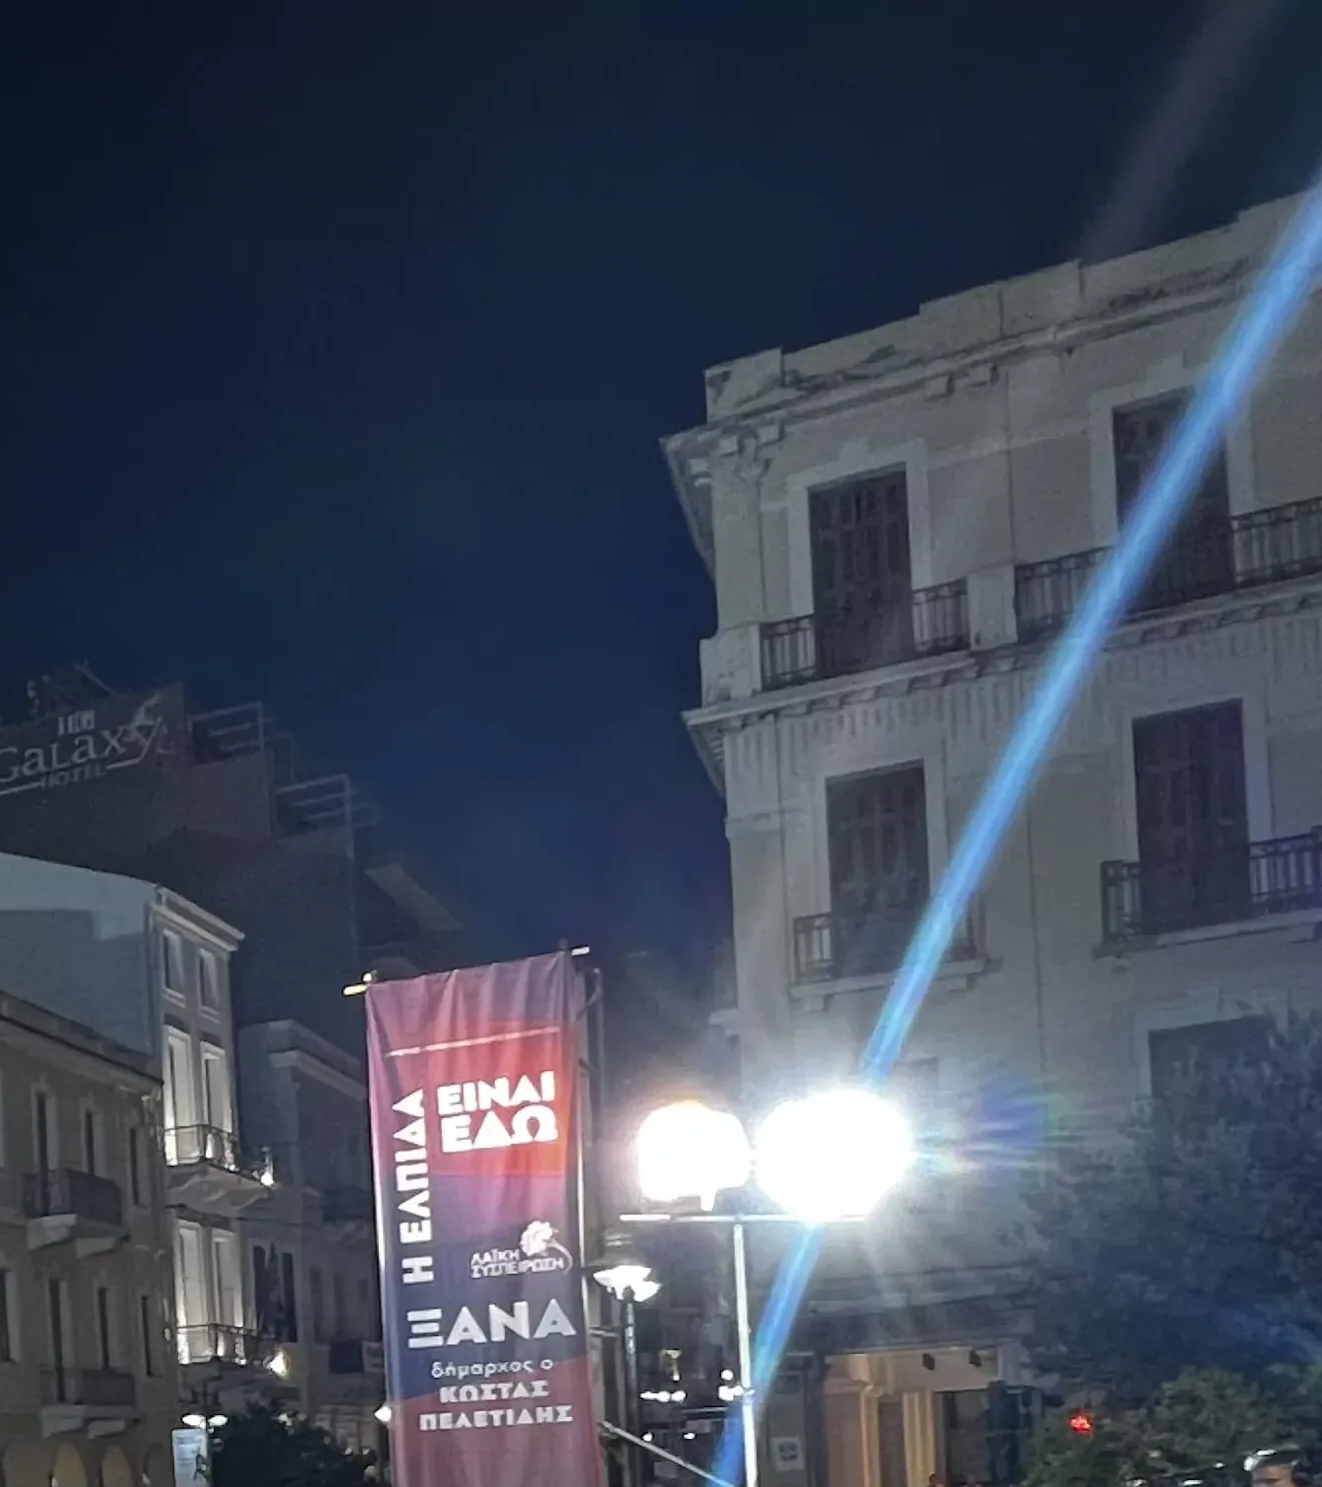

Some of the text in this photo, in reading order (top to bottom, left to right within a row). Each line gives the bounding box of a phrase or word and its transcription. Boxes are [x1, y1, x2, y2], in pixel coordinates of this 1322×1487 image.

[437, 1070, 556, 1116] ΕΙΝΑΙ
[441, 1104, 559, 1153] ΕΔΩ
[391, 1088, 435, 1285] Η ΕΛΠΙΔΑ
[470, 1256, 565, 1279] ΣΥΣΠΕΙΡΩΣΗ
[407, 1298, 577, 1349] ΞΑΝΑ
[431, 1358, 554, 1379] δήμαρχος ο
[440, 1380, 550, 1404] ΚΩΣΤΑΣ
[419, 1405, 574, 1431] ΠΕΛΕΤΙΔΗΣ
